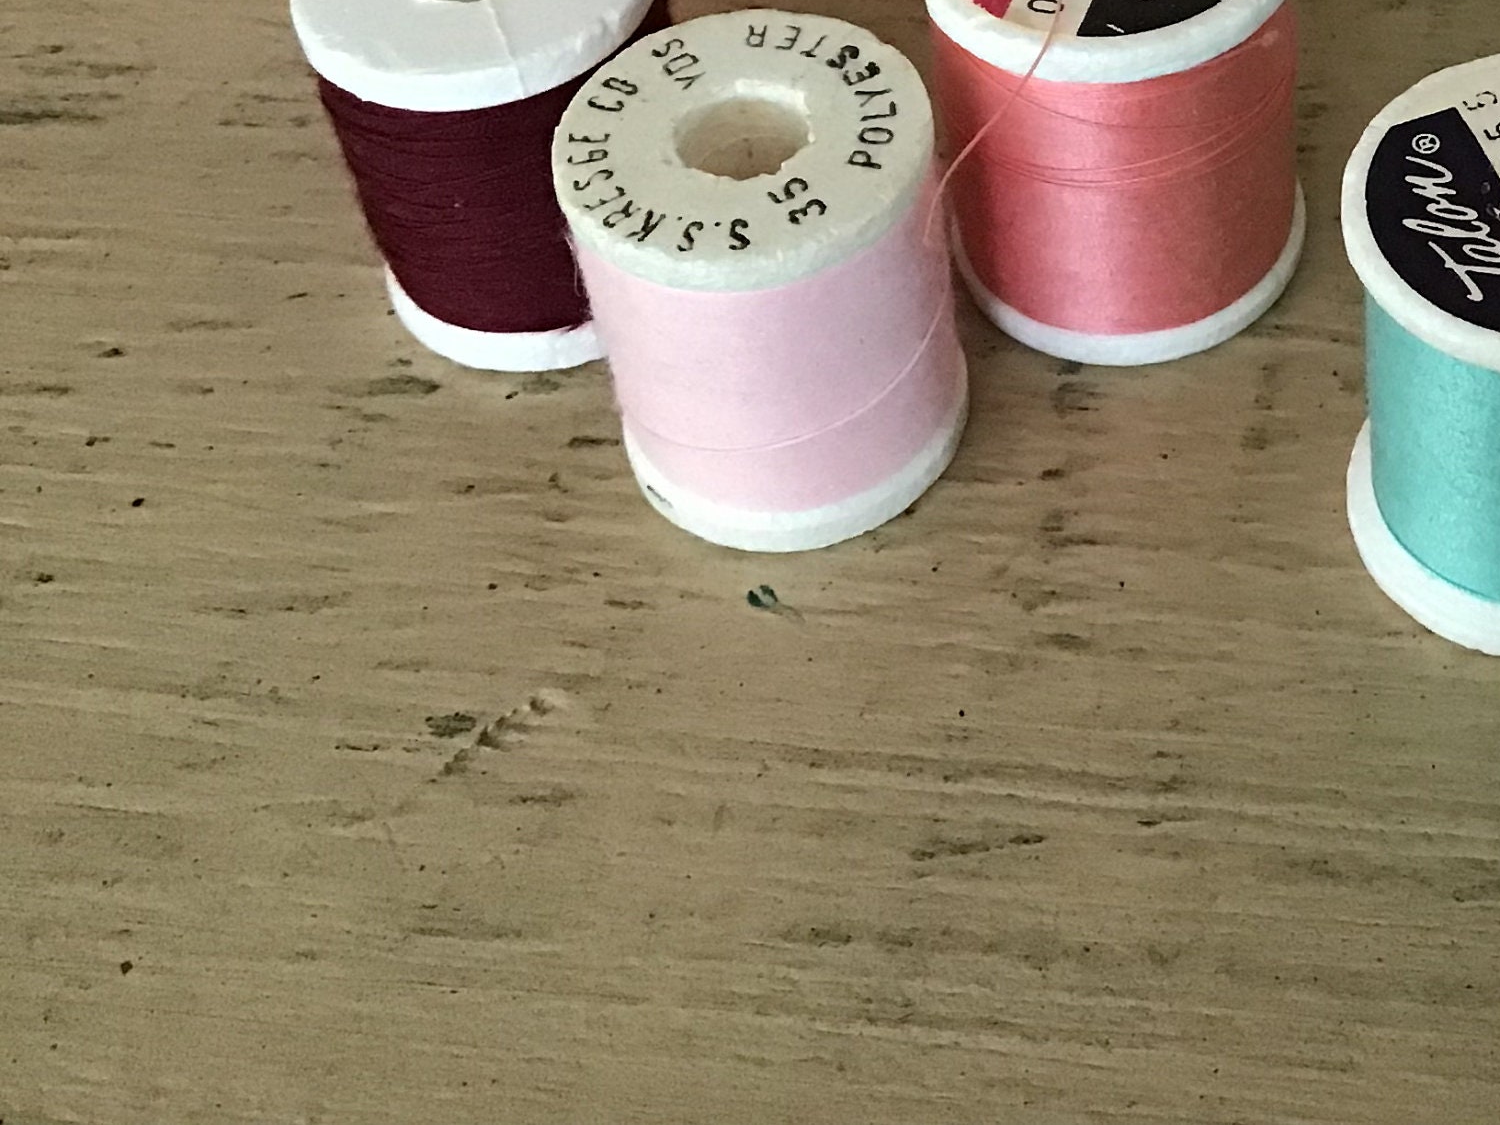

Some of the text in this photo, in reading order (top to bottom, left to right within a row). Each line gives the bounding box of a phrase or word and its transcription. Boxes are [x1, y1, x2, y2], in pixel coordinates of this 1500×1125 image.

[651, 38, 827, 225] 35 YDS
[745, 24, 897, 170] POLYESTER
